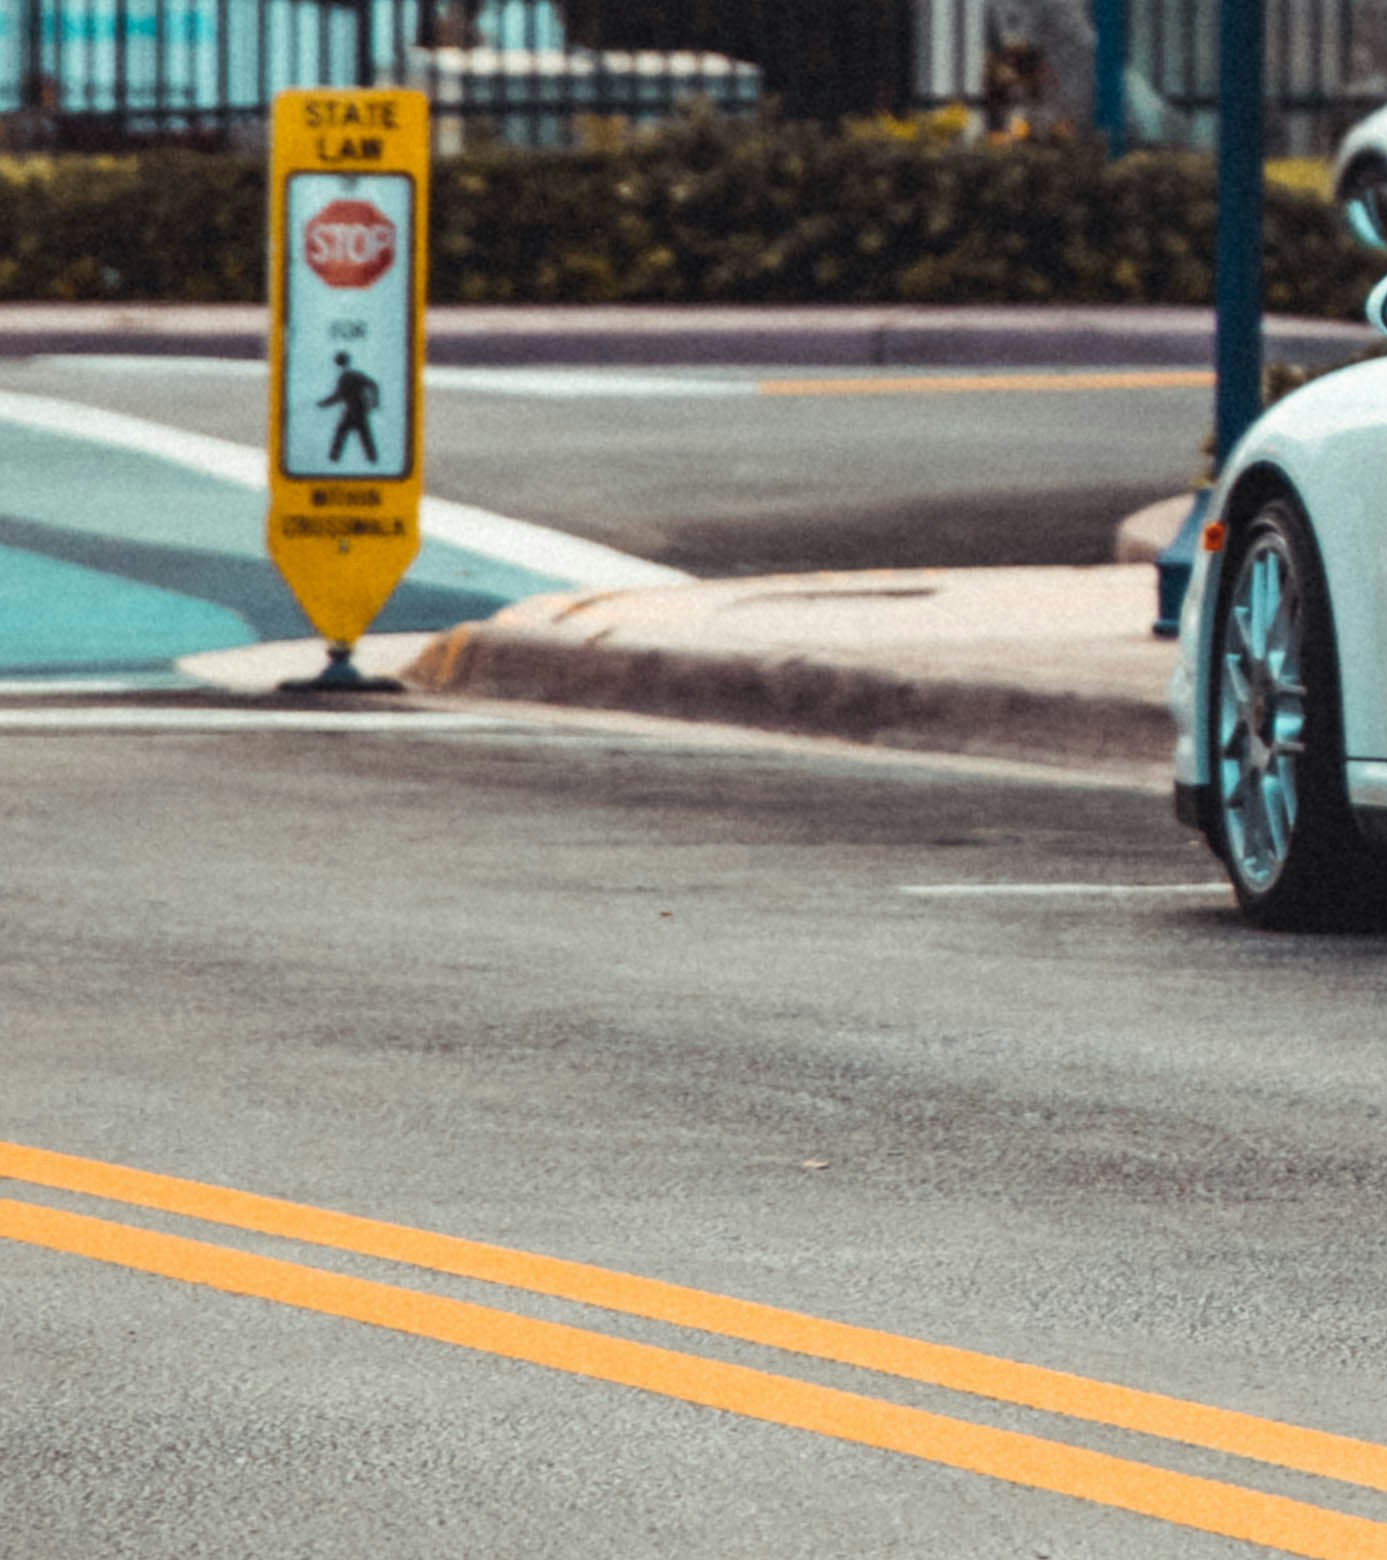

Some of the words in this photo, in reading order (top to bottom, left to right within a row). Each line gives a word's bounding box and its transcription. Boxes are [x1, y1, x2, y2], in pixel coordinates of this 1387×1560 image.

[305, 99, 399, 129] STATE
[315, 137, 384, 163] LAW
[310, 221, 395, 264] STOP
